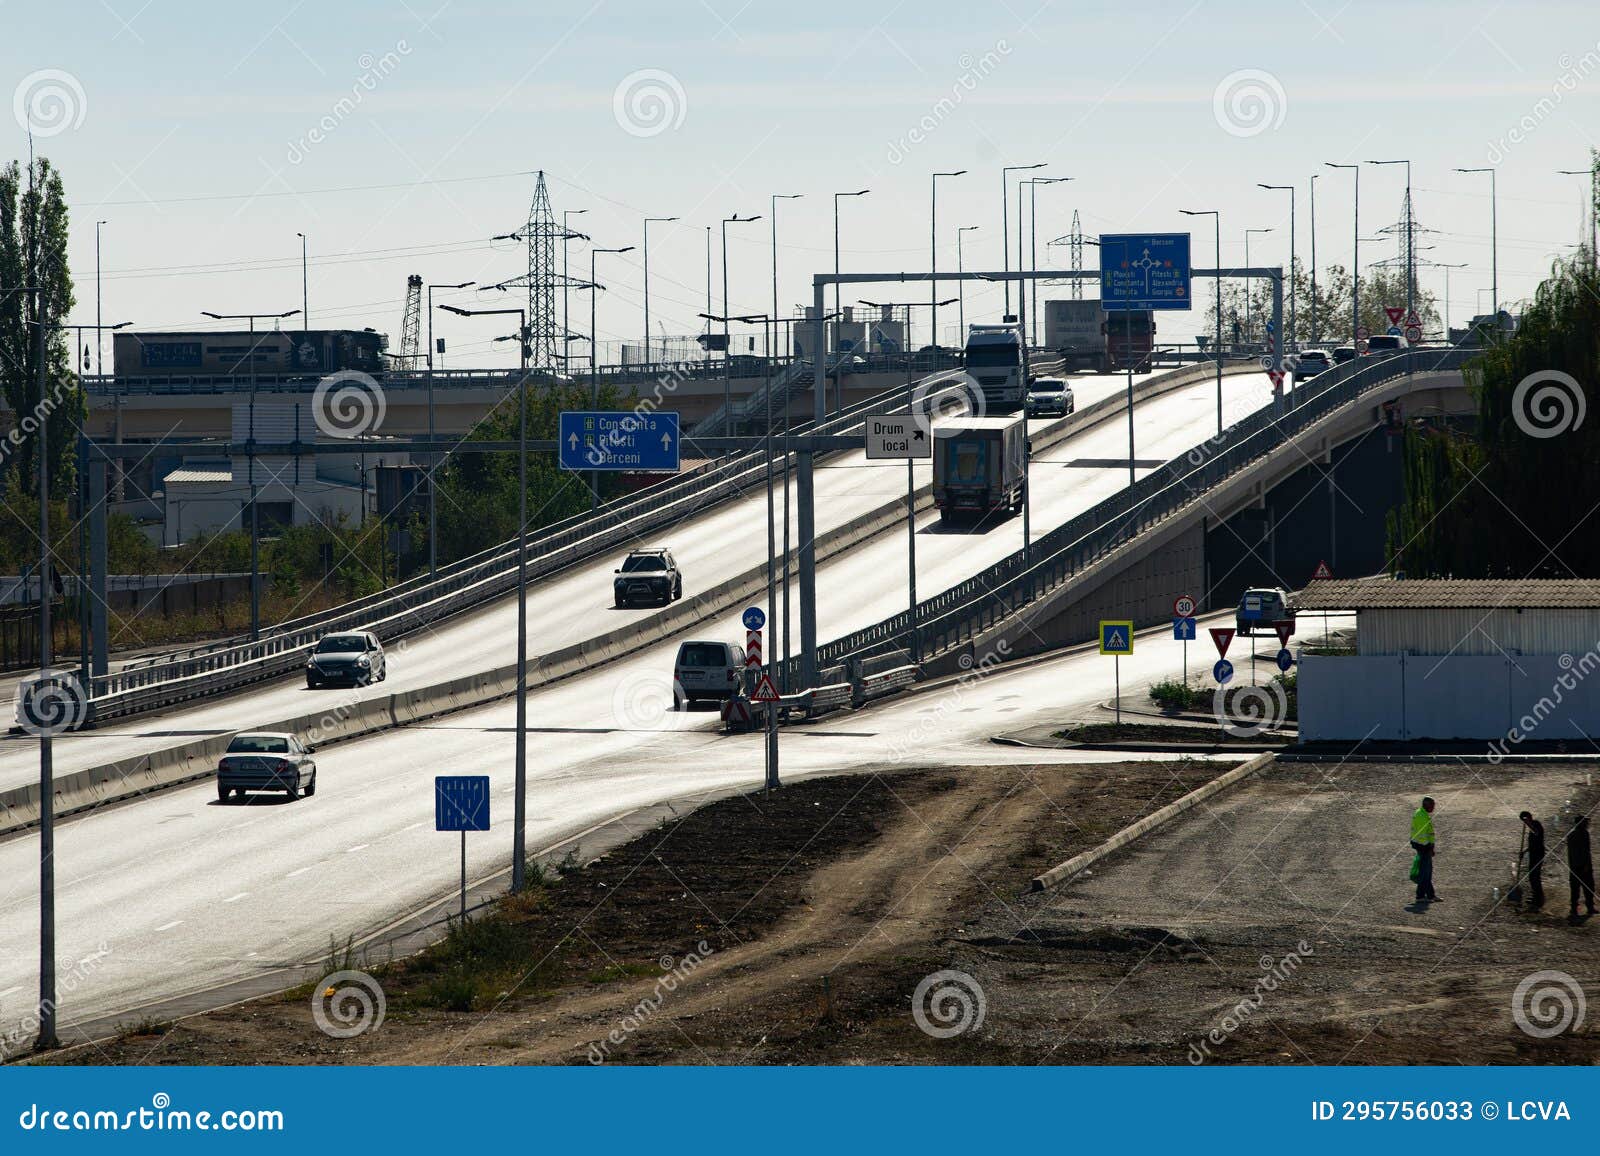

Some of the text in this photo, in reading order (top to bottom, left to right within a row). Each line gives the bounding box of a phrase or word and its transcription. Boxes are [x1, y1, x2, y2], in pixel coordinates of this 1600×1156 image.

[874, 422, 904, 435] Drum
[882, 439, 909, 452] local
[1179, 601, 1191, 612] 30
